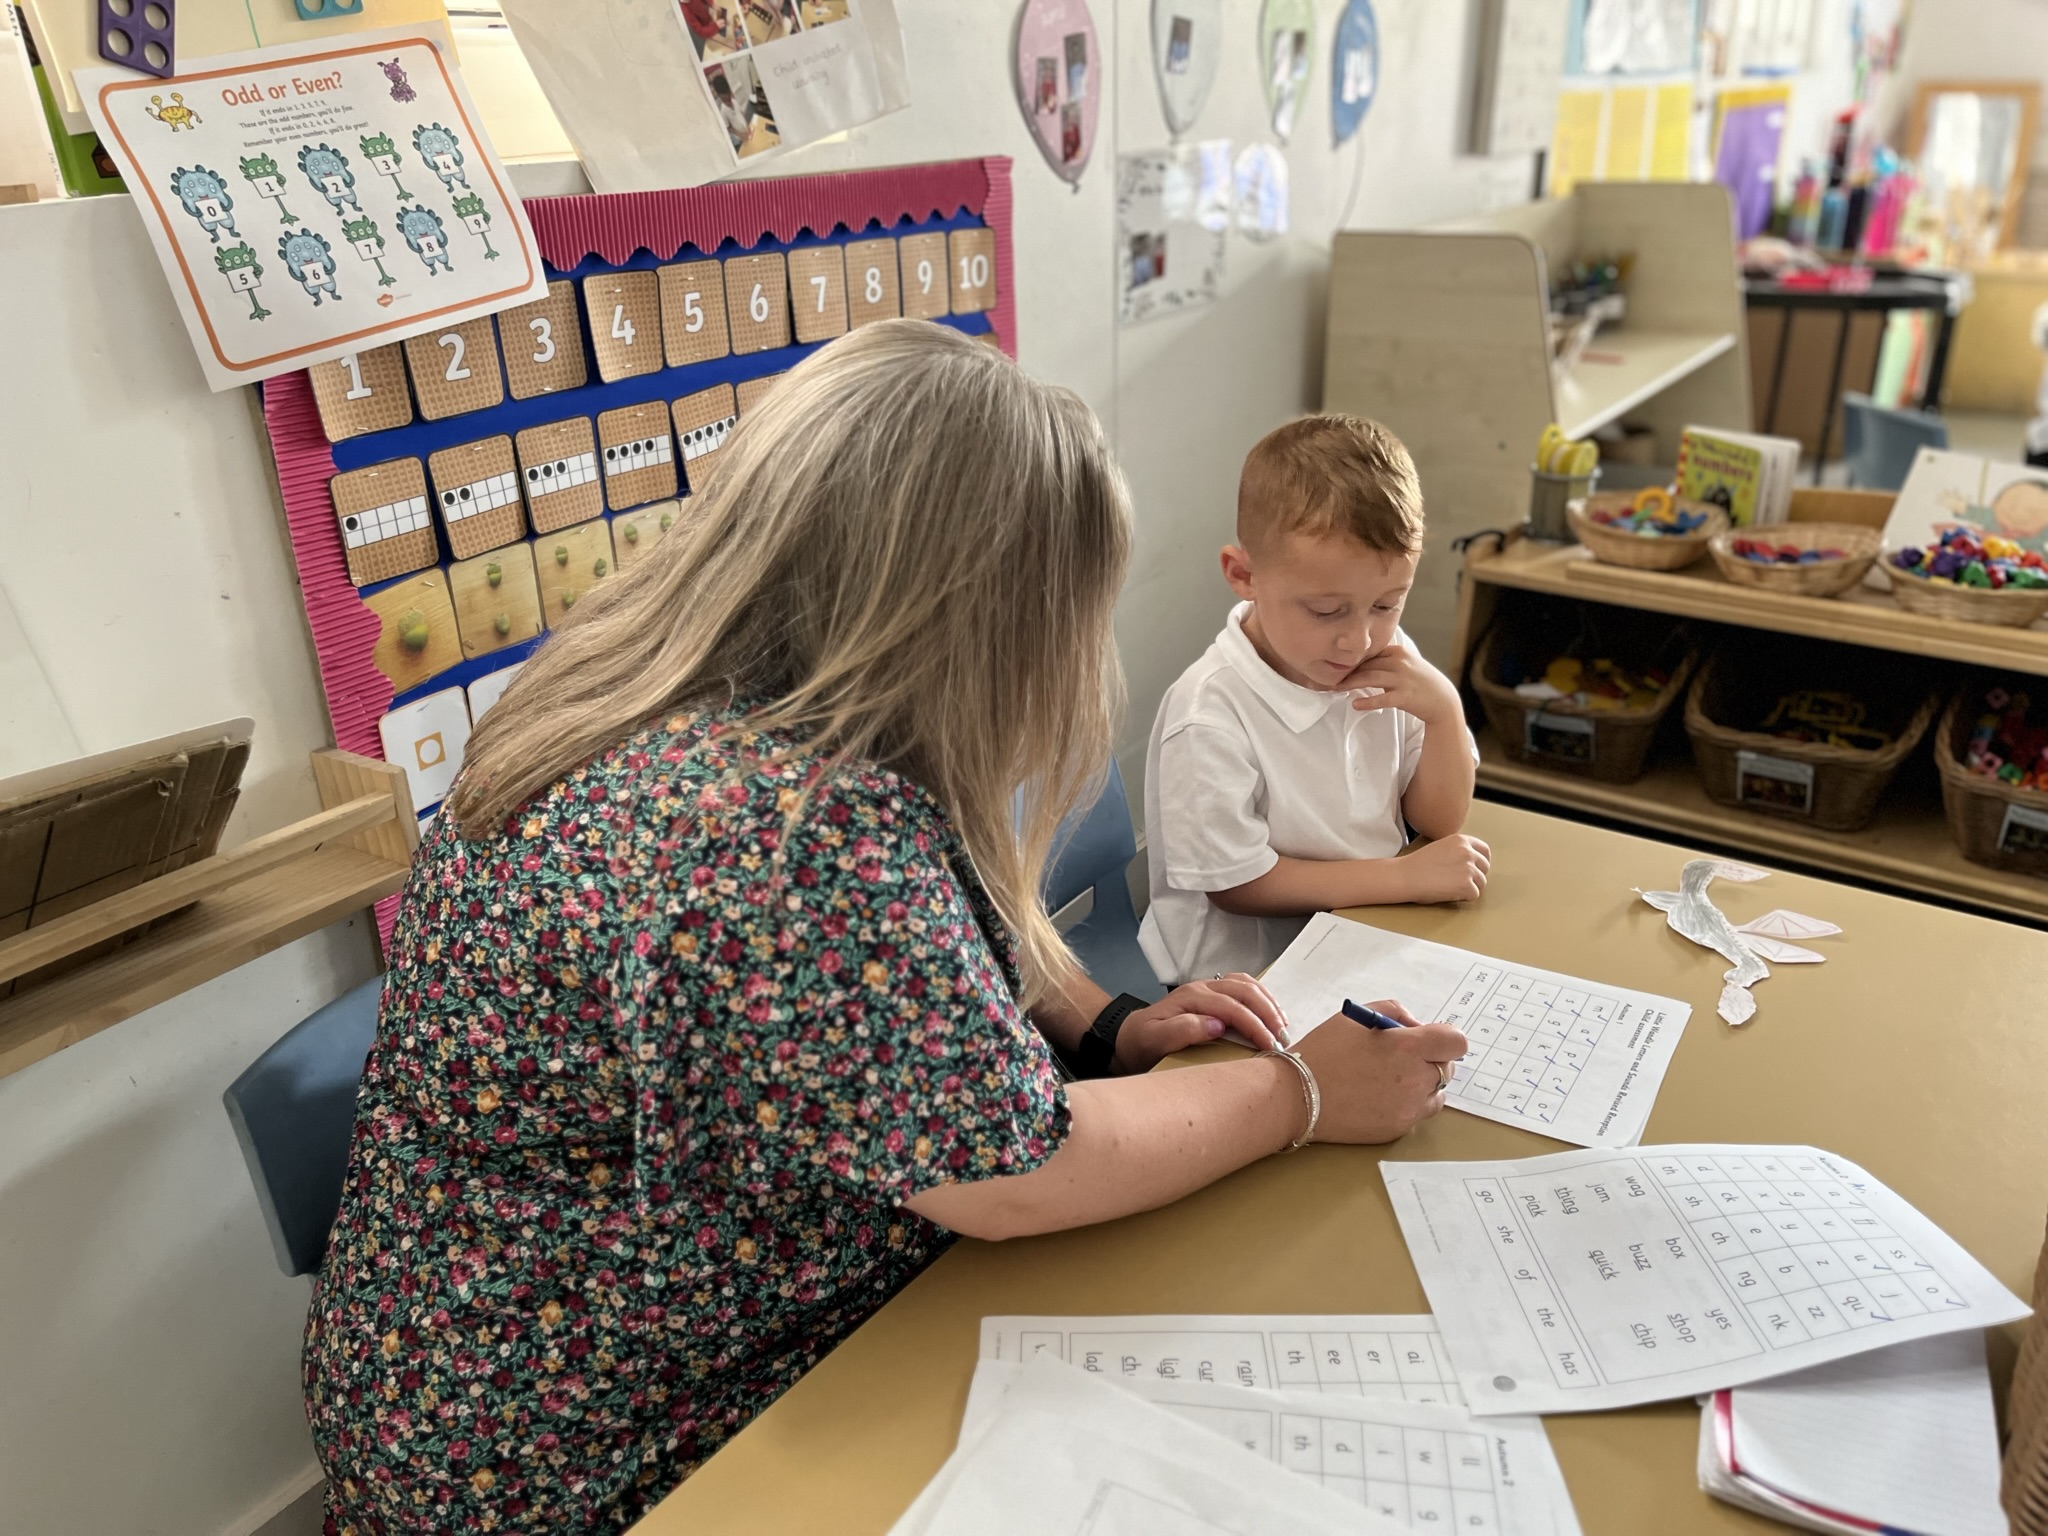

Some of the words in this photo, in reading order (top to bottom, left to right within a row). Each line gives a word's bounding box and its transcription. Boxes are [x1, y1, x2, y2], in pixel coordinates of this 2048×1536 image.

[221, 83, 264, 106] Odd
[268, 84, 287, 100] or
[292, 71, 343, 95] Even?
[207, 206, 216, 217] 0
[265, 182, 275, 192] 1
[332, 182, 341, 194] 2
[382, 160, 390, 170] 3
[443, 160, 451, 172] 4
[239, 274, 248, 285] 5
[312, 269, 320, 280] 6
[364, 244, 372, 255] 7
[426, 242, 435, 253] 8
[474, 219, 482, 229] 9
[340, 354, 372, 400] 1
[438, 334, 471, 382] 2
[528, 317, 556, 363] 3
[611, 304, 636, 346] 4
[684, 292, 704, 333] 5
[750, 283, 769, 323] 6
[810, 276, 826, 313] 7
[865, 267, 883, 304] 8
[918, 260, 933, 294] 9
[960, 254, 989, 290] 10
[1475, 972, 1488, 982] sat
[1459, 992, 1474, 1005] man
[1495, 1004, 1508, 1012] ck
[1593, 1005, 1603, 1013] m
[1618, 1003, 1632, 1020] Autumn
[1641, 1009, 1654, 1022] Child
[1654, 1012, 1667, 1025] Little
[1628, 1022, 1644, 1048] assessment
[1644, 1026, 1660, 1044] Wandle
[1563, 1051, 1576, 1059] p
[1636, 1044, 1651, 1061] Letters
[1630, 1062, 1639, 1072] and
[1474, 1083, 1490, 1092] f
[1621, 1072, 1637, 1090] Sounds
[1610, 1091, 1627, 1112] Revised
[1596, 1112, 1617, 1136] Reception
[1817, 1157, 1840, 1174] Autumn
[1520, 1194, 1547, 1218] pink
[1625, 1175, 1646, 1198] wag
[1665, 1237, 1686, 1259] box
[1705, 1308, 1732, 1330] yes
[1662, 1165, 1678, 1175] th
[1685, 1196, 1704, 1207] sh
[1711, 1231, 1730, 1245] ch
[1738, 1271, 1757, 1288] ng
[1768, 1313, 1790, 1331] nk
[1721, 1192, 1739, 1202] ck
[1779, 1265, 1795, 1274] b
[1808, 1305, 1825, 1319] zz
[1890, 1249, 1906, 1259] ss
[1554, 1187, 1579, 1215] thing
[1588, 1249, 1620, 1281] quick
[1630, 1322, 1657, 1350] chip
[1586, 1183, 1610, 1203] jam
[1628, 1243, 1652, 1271] buzz
[1667, 1313, 1696, 1343] shop
[1476, 1190, 1494, 1203] go
[1497, 1225, 1514, 1244] she
[1514, 1268, 1537, 1281] of
[1536, 1307, 1555, 1328] the
[1558, 1352, 1579, 1376] has
[1842, 1296, 1865, 1312] qu
[1288, 1350, 1306, 1365] th
[1328, 1350, 1340, 1365] ee
[1367, 1350, 1381, 1364] er
[1407, 1351, 1424, 1364] ai
[1237, 1361, 1257, 1387] rain
[1294, 1436, 1312, 1450] th
[1335, 1443, 1354, 1454] d
[1419, 1451, 1432, 1464] w
[1462, 1457, 1480, 1466] ll
[1496, 1437, 1509, 1476] Autumn
[1503, 1480, 1514, 1488] 2
[1418, 1511, 1438, 1521] g
[1470, 1516, 1483, 1526] a
